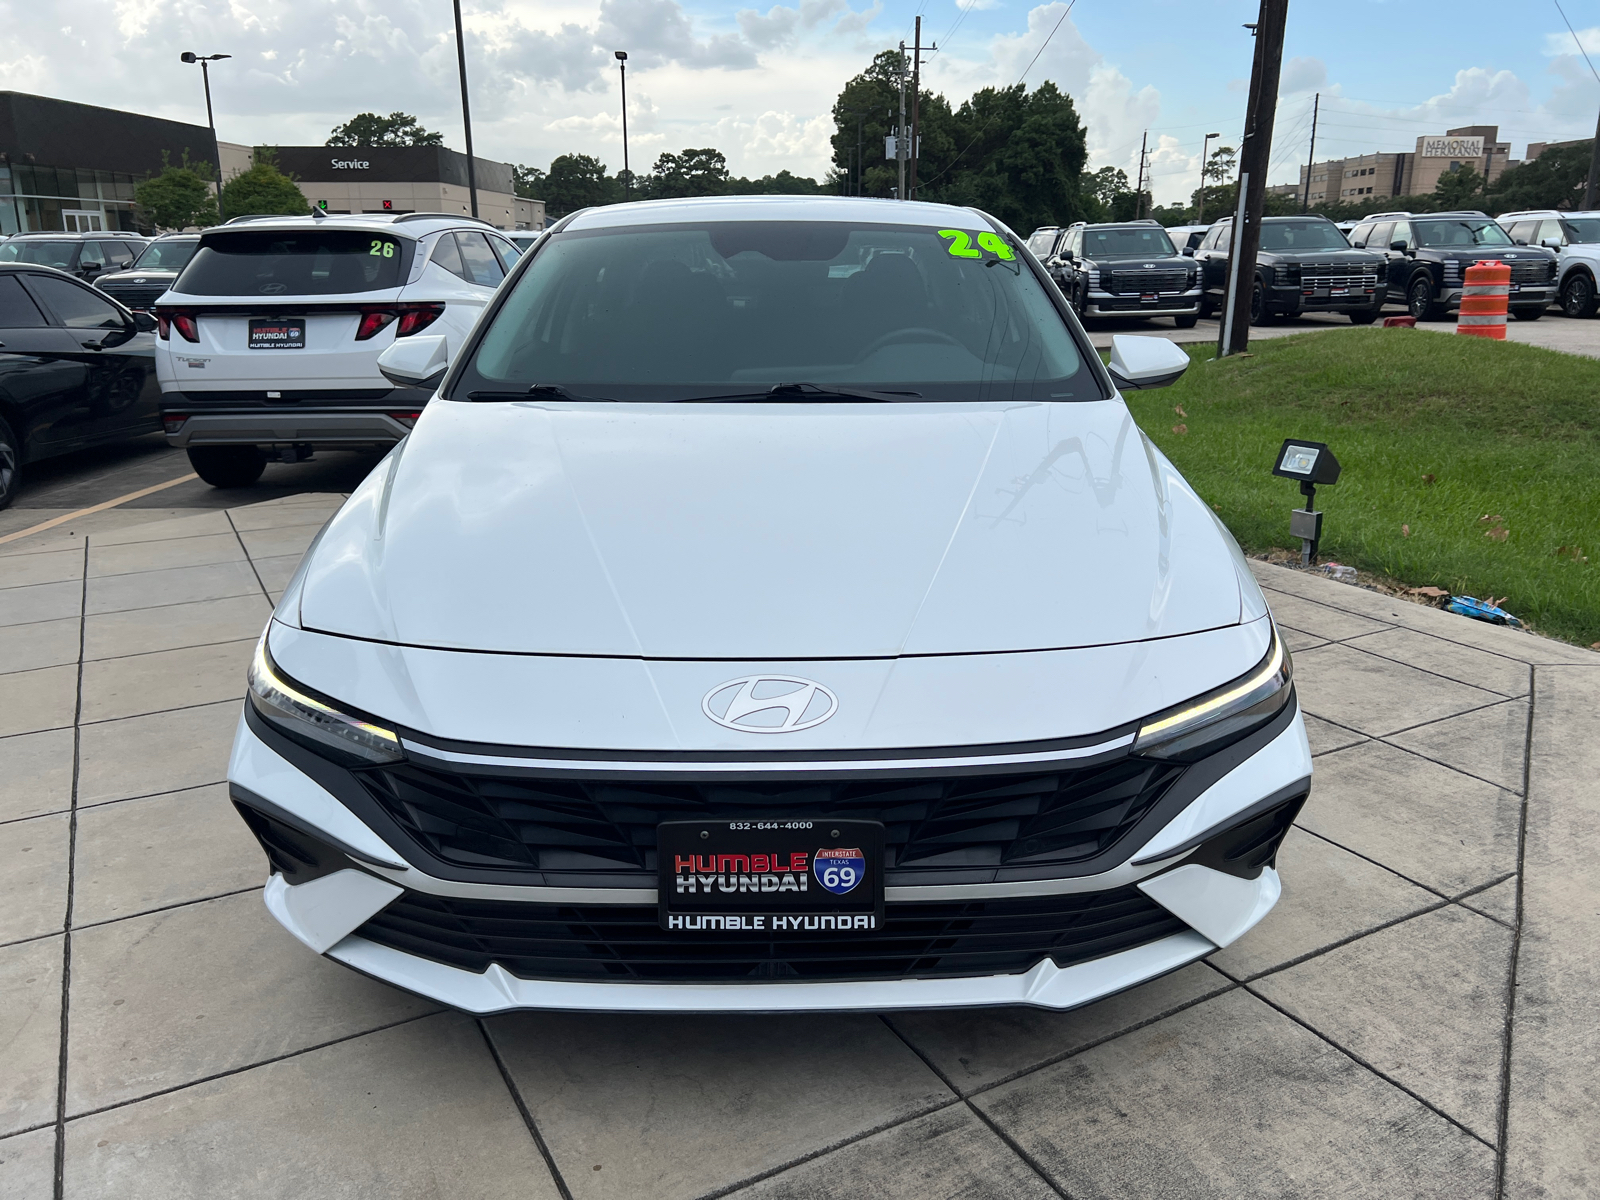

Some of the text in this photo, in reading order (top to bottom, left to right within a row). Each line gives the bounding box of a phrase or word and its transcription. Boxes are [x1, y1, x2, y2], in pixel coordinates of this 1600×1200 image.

[1425, 147, 1480, 156] HERMANN
[1426, 140, 1481, 150] MEMORIAL
[331, 159, 370, 169] Service
[369, 240, 395, 258] 26
[937, 229, 1017, 261] 24
[729, 821, 813, 830] 832-644-4000
[674, 852, 809, 873] HUMBLE
[676, 873, 808, 894] HYUNDAI
[823, 867, 856, 888] 69
[668, 915, 876, 930] HUMBLE HYUNDAI
